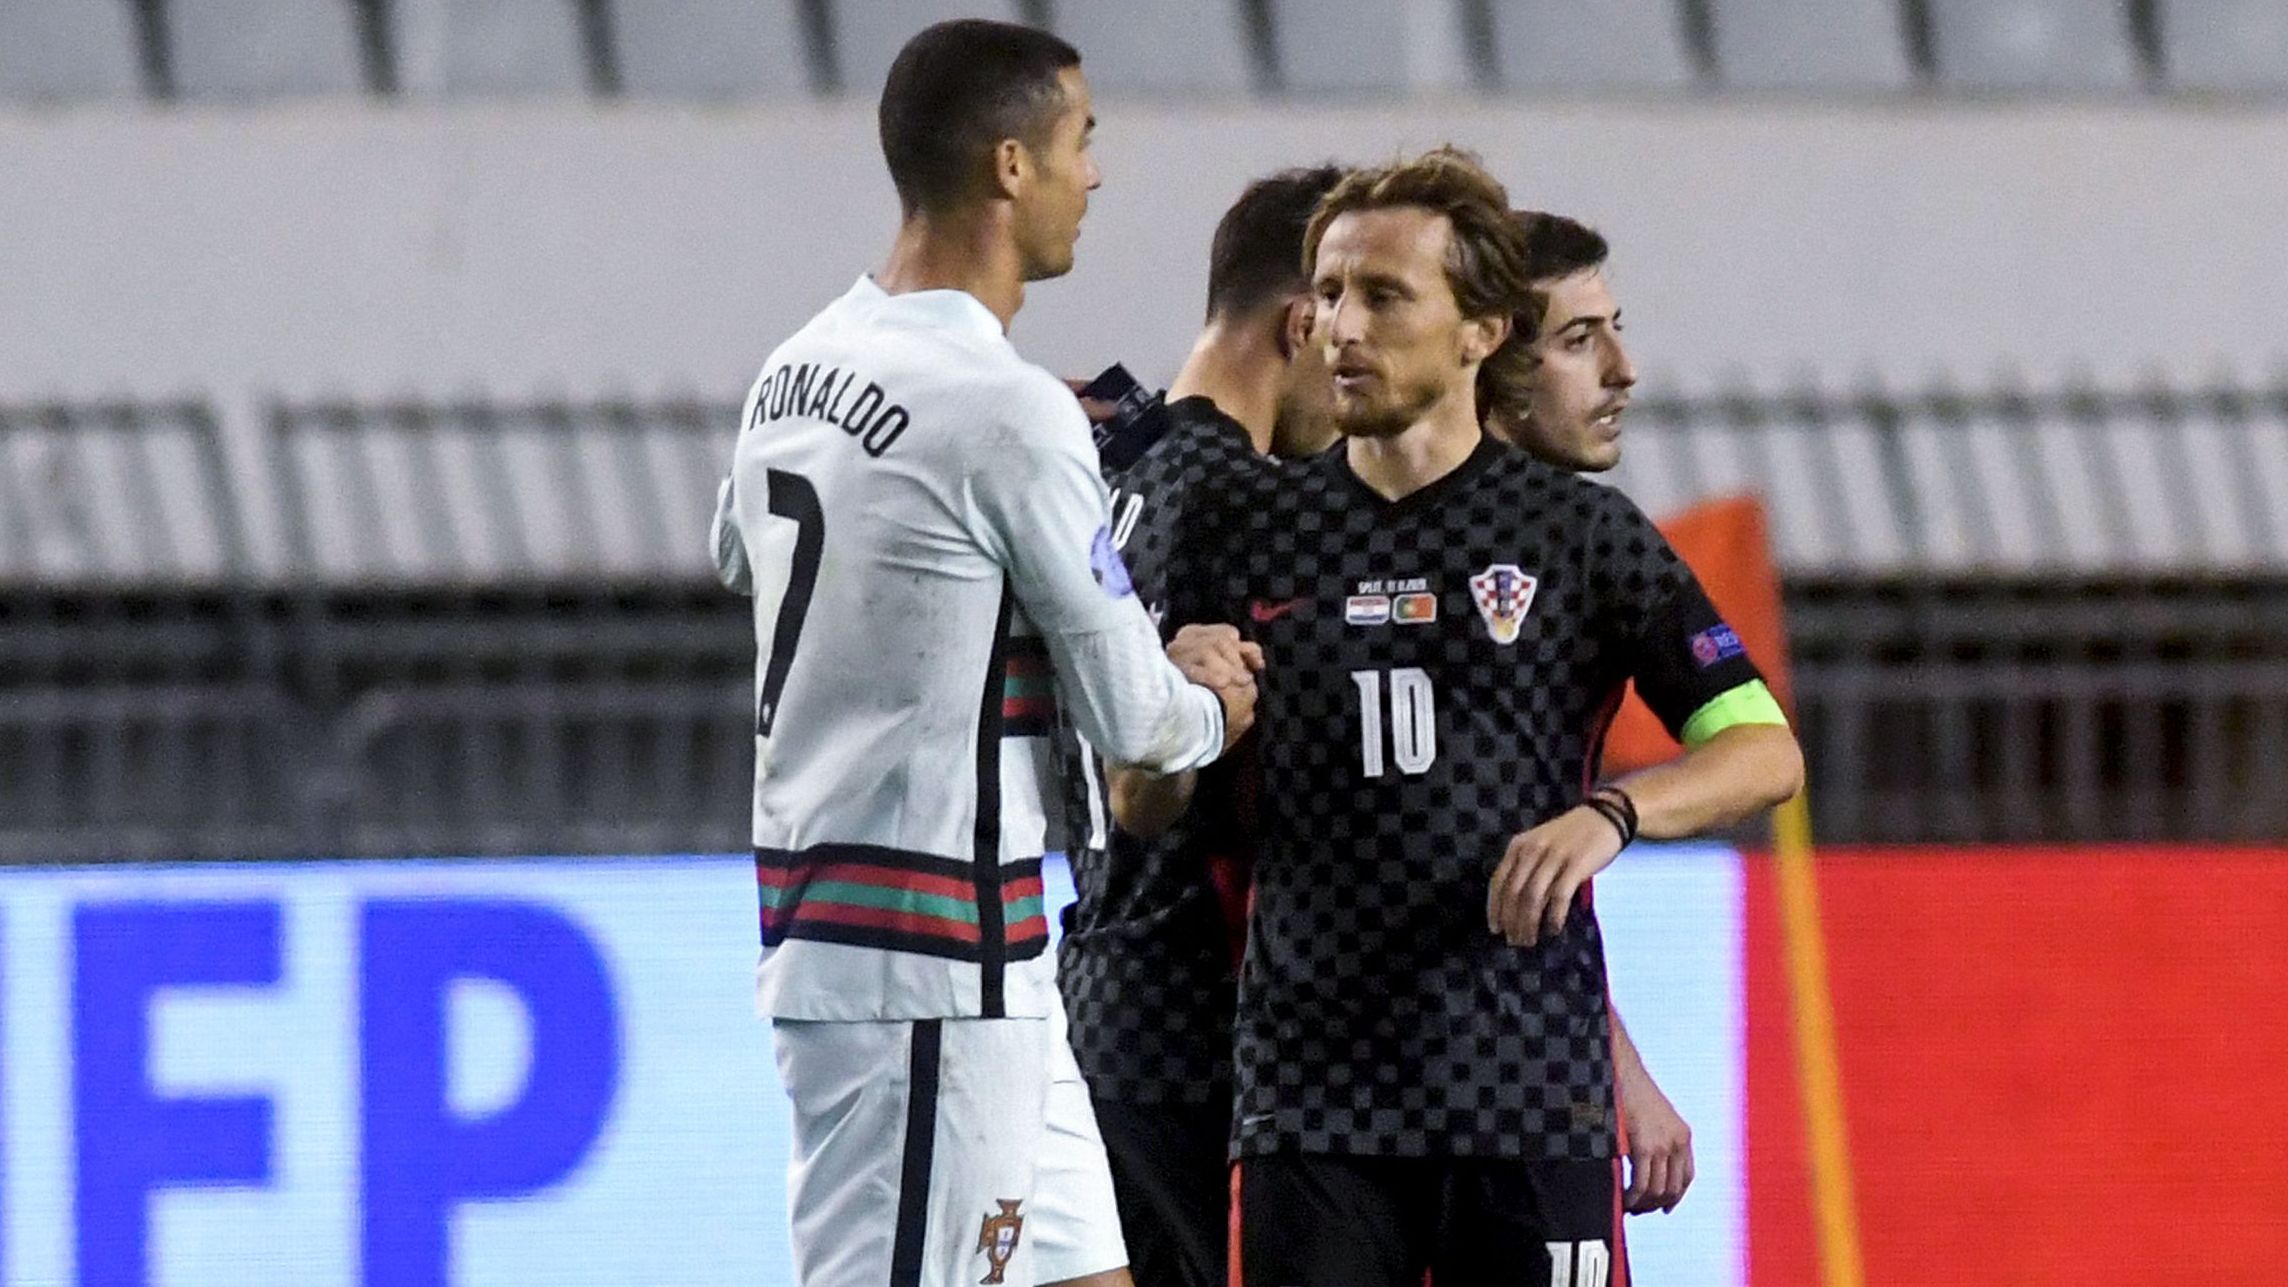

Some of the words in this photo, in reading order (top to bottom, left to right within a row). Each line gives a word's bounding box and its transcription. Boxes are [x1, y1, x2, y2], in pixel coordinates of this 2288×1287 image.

[749, 363, 910, 458] RONALDO
[757, 467, 826, 738] 7
[1351, 667, 1436, 778] 10
[1545, 1239, 1609, 1287] 10
